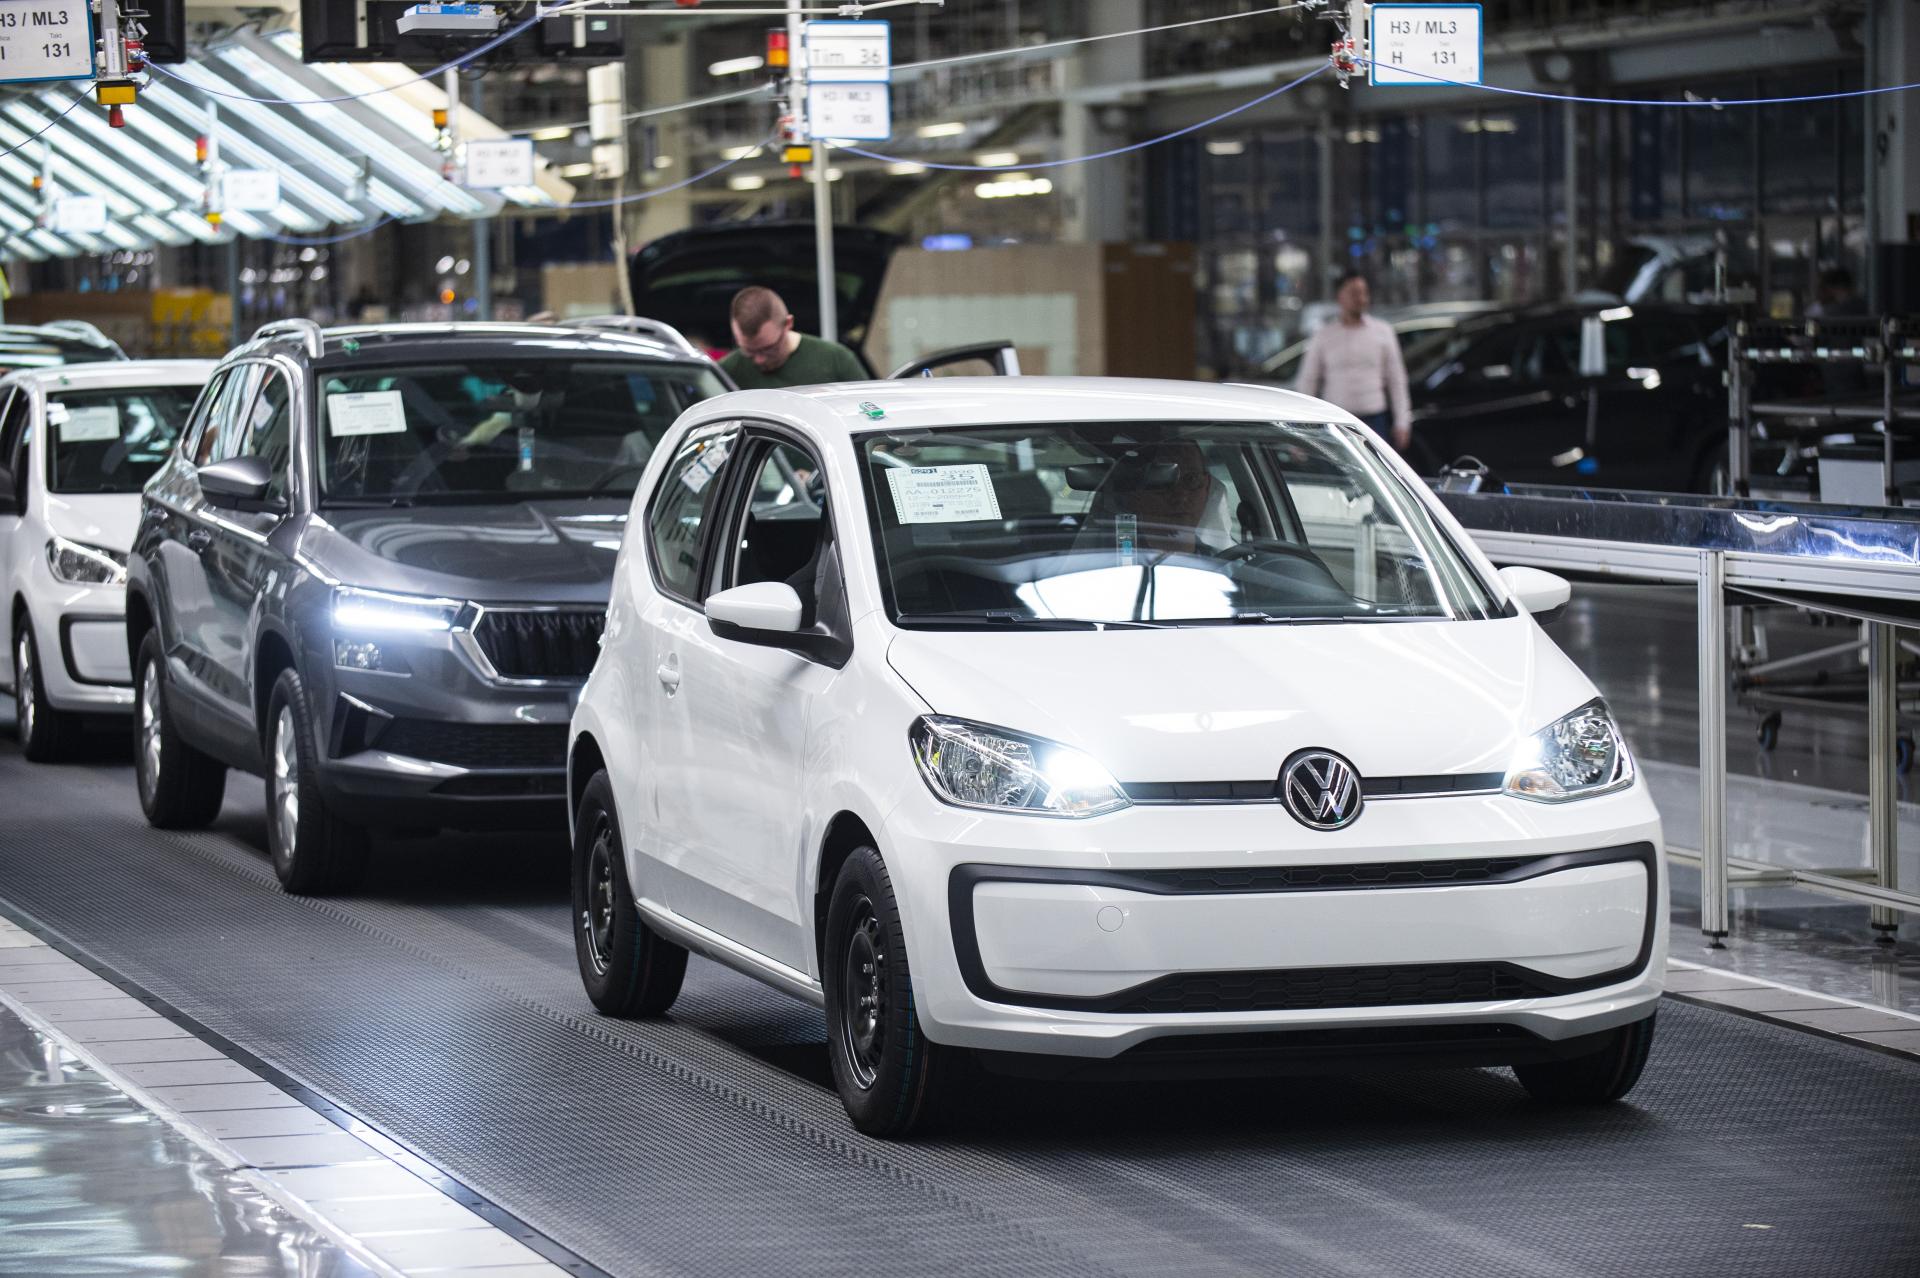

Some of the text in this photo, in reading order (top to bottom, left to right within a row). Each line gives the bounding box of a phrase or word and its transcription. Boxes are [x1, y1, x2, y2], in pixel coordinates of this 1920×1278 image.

[22, 12, 26, 27] /
[32, 10, 69, 26] ML3
[1390, 21, 1411, 34] H3
[1425, 21, 1457, 34] ML3
[42, 43, 70, 58] 131
[1391, 51, 1402, 64] H
[1431, 51, 1457, 64] 131
